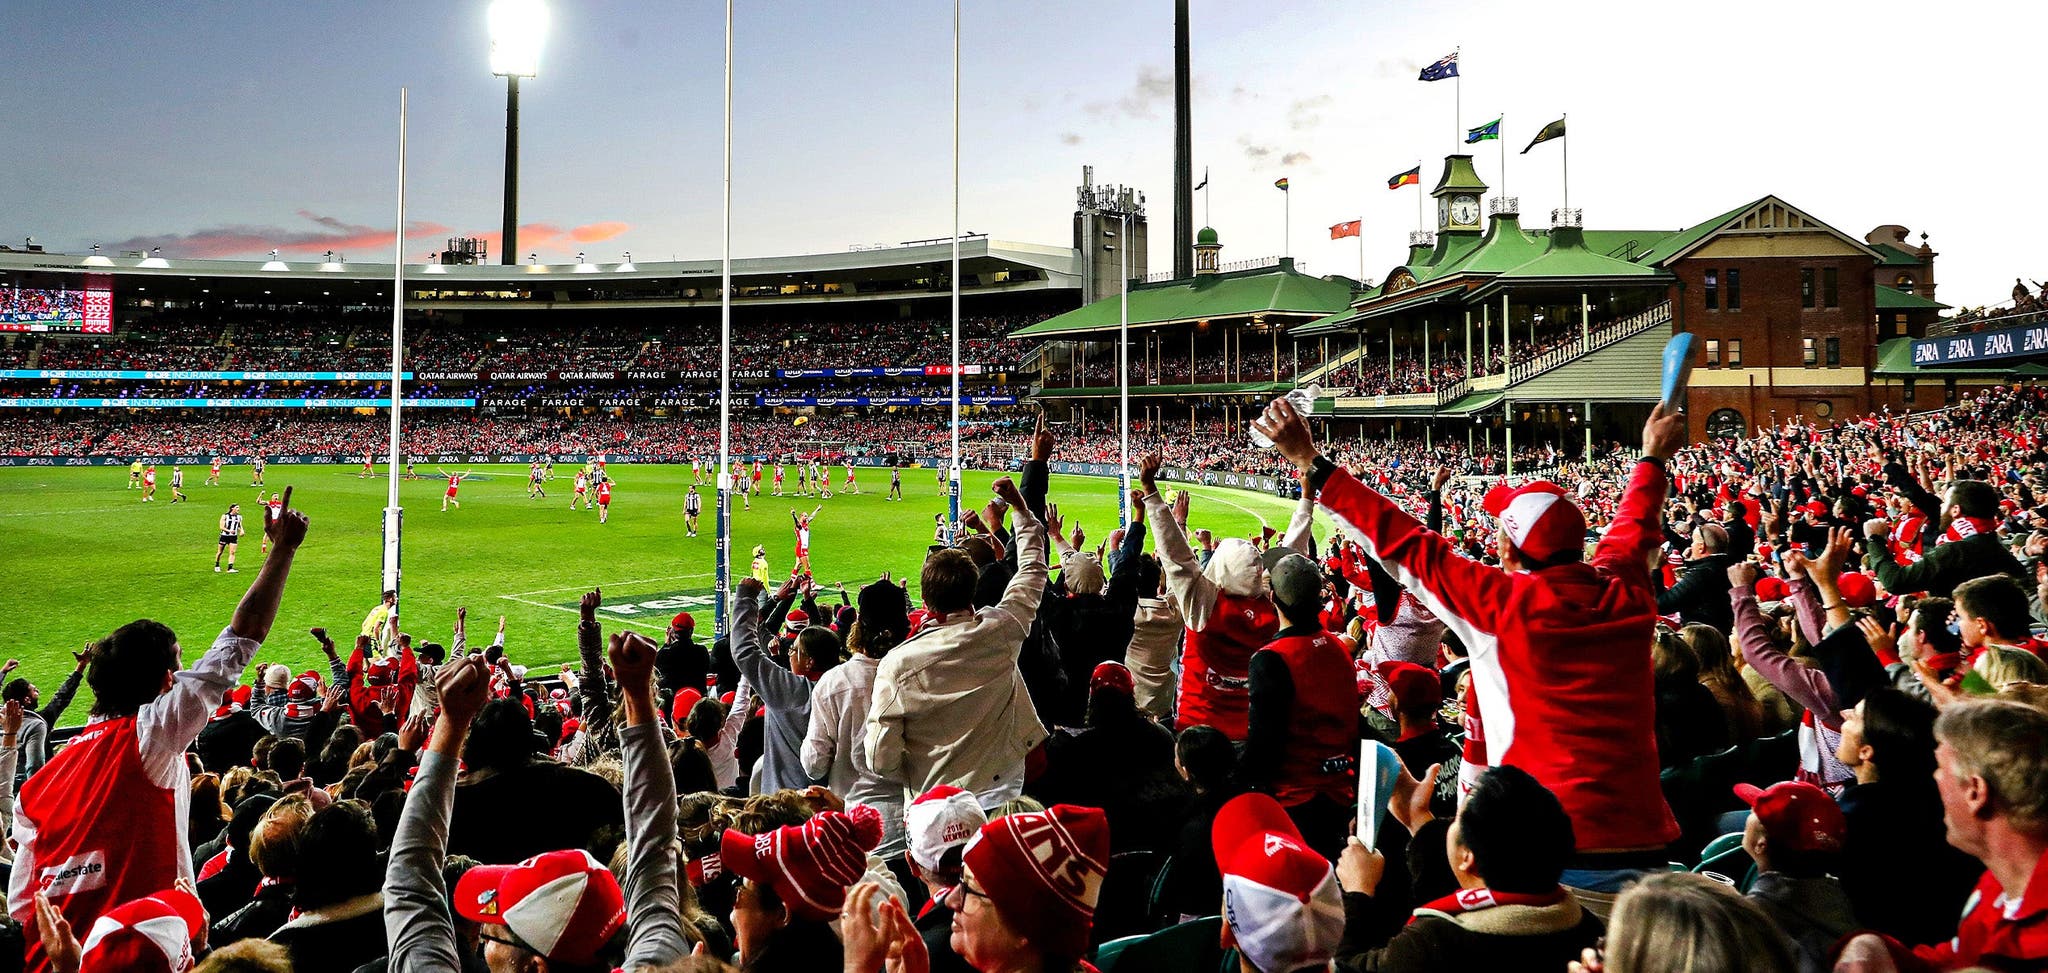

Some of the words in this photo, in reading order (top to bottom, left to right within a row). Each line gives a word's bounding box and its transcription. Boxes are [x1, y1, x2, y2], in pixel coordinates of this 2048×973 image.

[86, 291, 94, 333] SYDNEY
[94, 291, 102, 333] SYDNEY
[102, 291, 111, 333] SYDNEY
[50, 370, 68, 378] QBE
[153, 371, 171, 379] QBE
[172, 371, 222, 379] INSURANCE
[252, 371, 267, 379] QBE
[268, 371, 316, 379] INSURANCE
[419, 371, 446, 380] QATAR
[447, 371, 478, 380] AIRWAYS
[490, 371, 517, 380] QATAR
[518, 371, 547, 379] AIRWAYS
[559, 371, 583, 380] QATAR
[584, 371, 614, 379] AIRWAYS
[628, 371, 666, 379] FARAGE
[680, 370, 718, 378] FARAGE
[732, 370, 770, 378] FARAGE
[20, 399, 79, 407] INSURANCE
[111, 399, 129, 407] QBE
[130, 399, 185, 407] INSURANCE
[215, 399, 233, 407] QBE
[233, 399, 285, 407] INSURANCE
[313, 399, 328, 407] QBE
[329, 399, 378, 407] INSURANCE
[421, 399, 466, 407] INSURANCE
[654, 398, 695, 406] FARAGE
[709, 398, 750, 406] FAAGE
[942, 829, 970, 843] MEMBER
